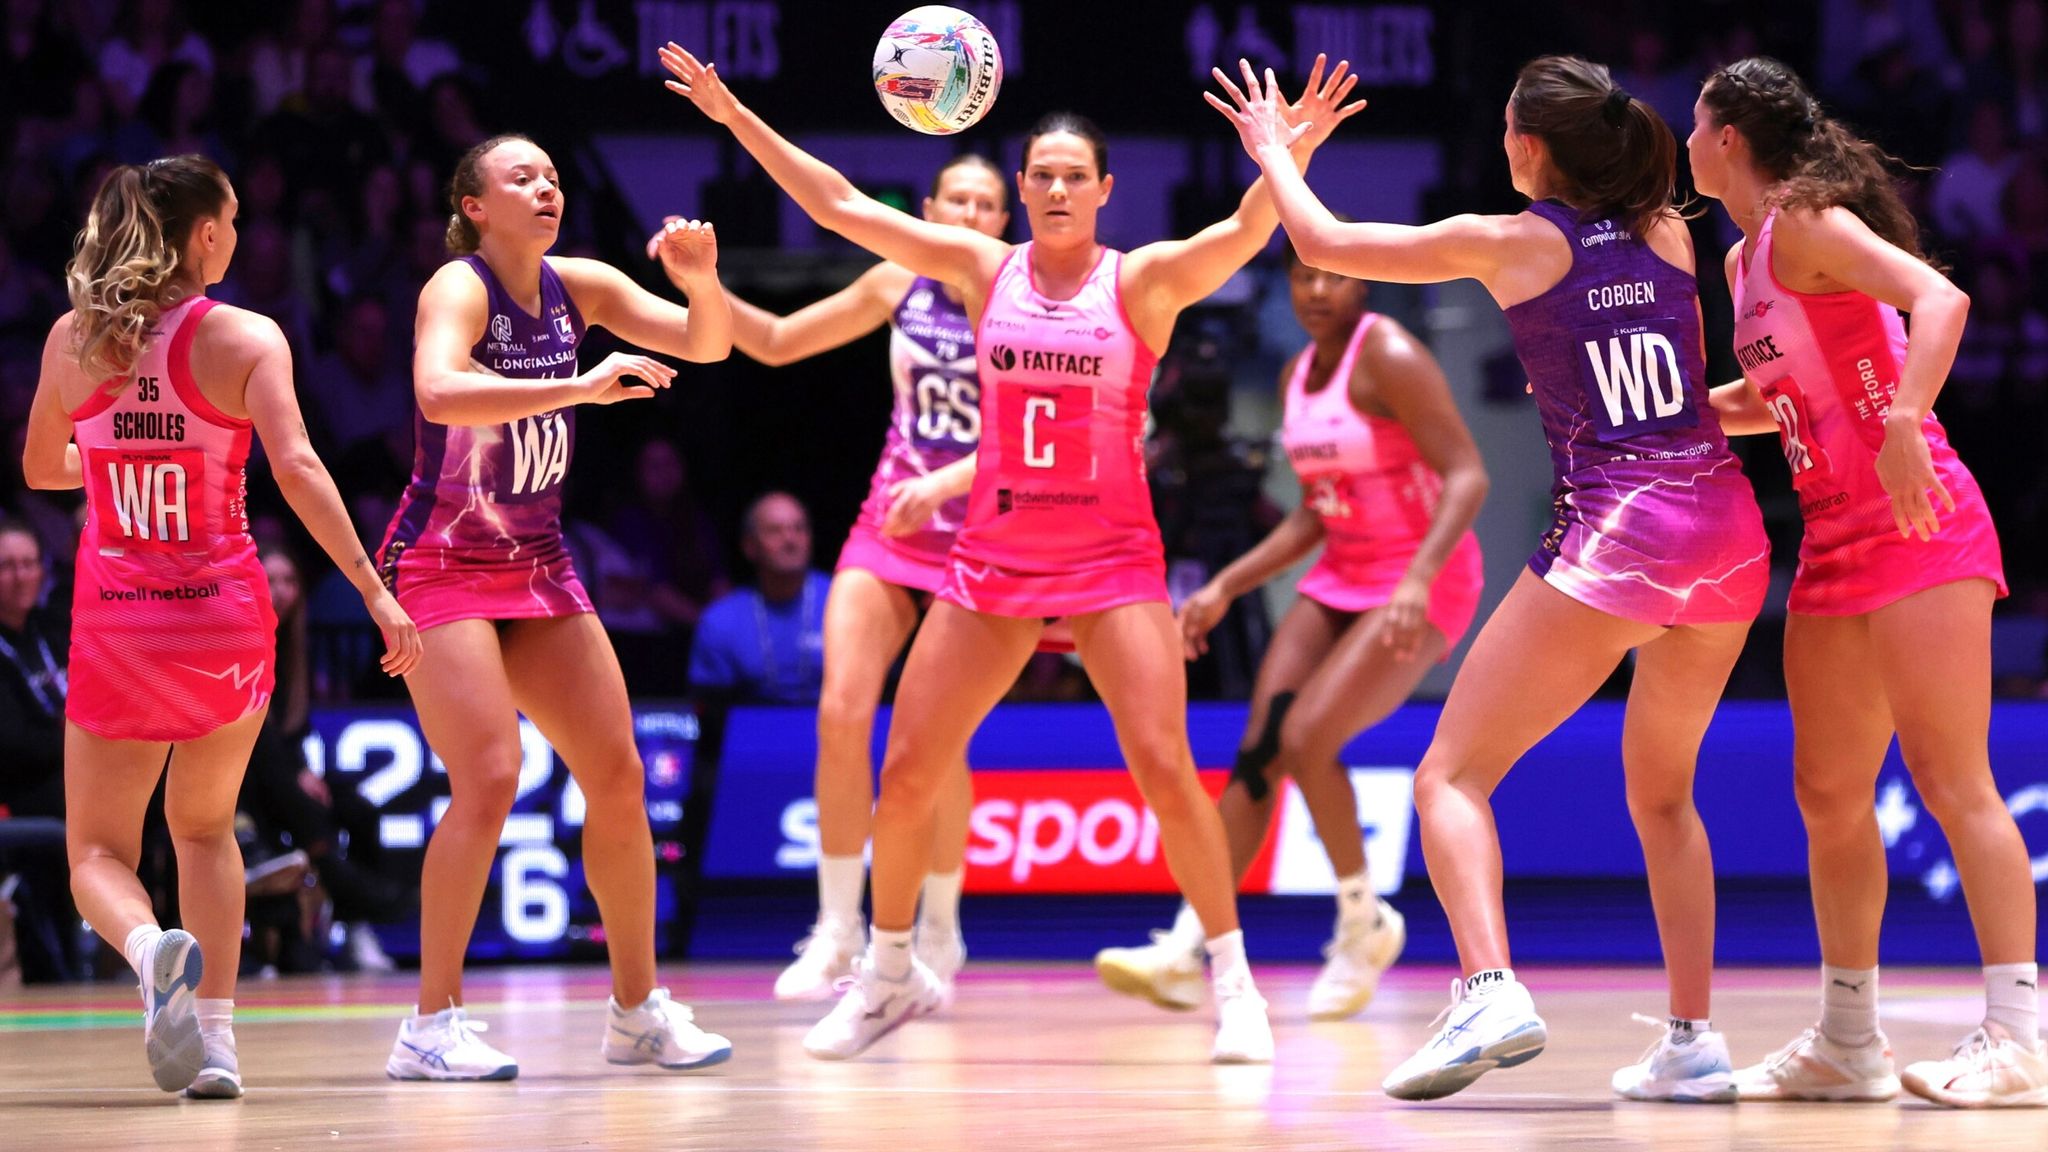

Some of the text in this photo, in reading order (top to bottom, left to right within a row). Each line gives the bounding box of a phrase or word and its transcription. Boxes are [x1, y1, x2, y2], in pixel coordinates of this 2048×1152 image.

[956, 36, 994, 125] GILBERT
[1587, 281, 1655, 311] COBDEN
[1620, 326, 1647, 334] KUKRI
[1022, 350, 1104, 376] FATFACE
[138, 377, 160, 402] 35
[1585, 333, 1684, 427] WD
[917, 373, 981, 443] GS
[1855, 399, 1871, 420] THE
[113, 412, 185, 442] SCHOLES
[1023, 397, 1057, 468] C
[508, 412, 568, 495] WA
[108, 462, 189, 542] WA
[1014, 489, 1099, 506] edwindoran
[99, 583, 220, 601] lovell netball
[502, 844, 570, 944] 6
